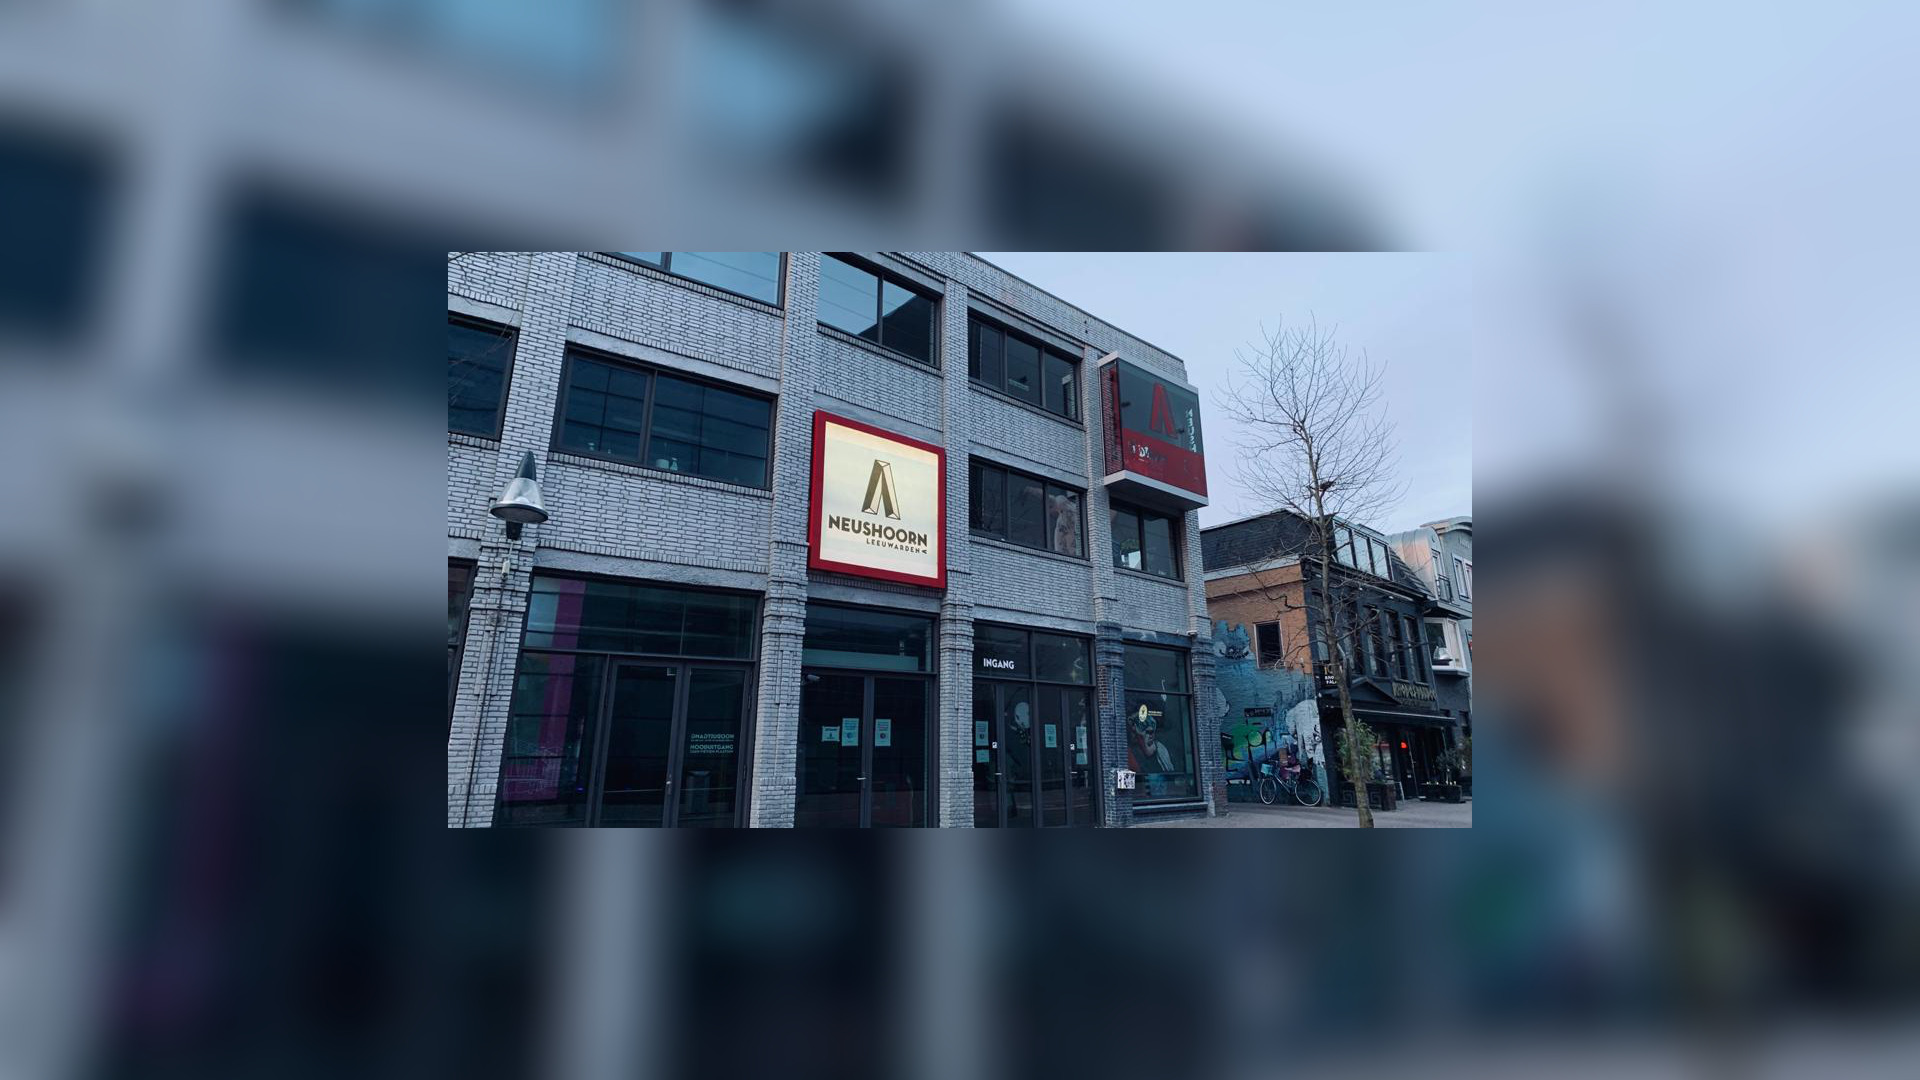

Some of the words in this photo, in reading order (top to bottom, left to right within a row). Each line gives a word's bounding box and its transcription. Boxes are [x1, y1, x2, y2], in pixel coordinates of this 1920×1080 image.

[828, 514, 928, 547] NEUSHOORN
[866, 538, 920, 554] LEEUWARDEN
[983, 658, 1015, 669] INGANG
